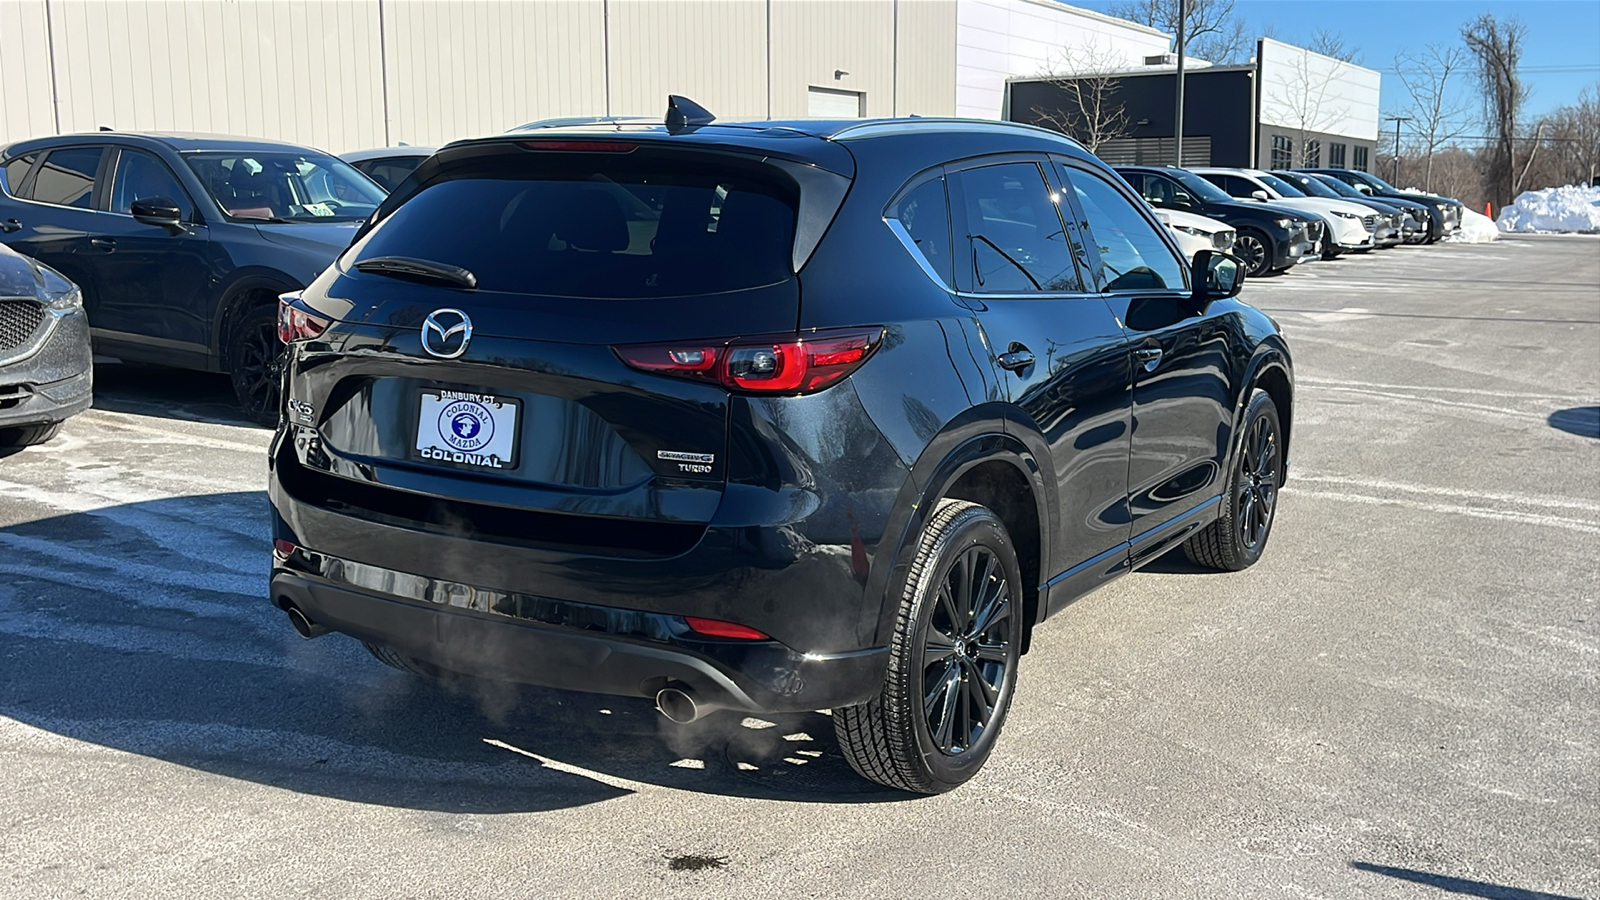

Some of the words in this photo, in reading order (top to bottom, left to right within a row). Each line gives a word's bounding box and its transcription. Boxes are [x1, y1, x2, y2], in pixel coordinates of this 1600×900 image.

[446, 404, 488, 424] COLONIAL
[449, 434, 482, 449] MAZDA
[421, 448, 502, 468] COLONIAL
[678, 463, 712, 473] TURBO
